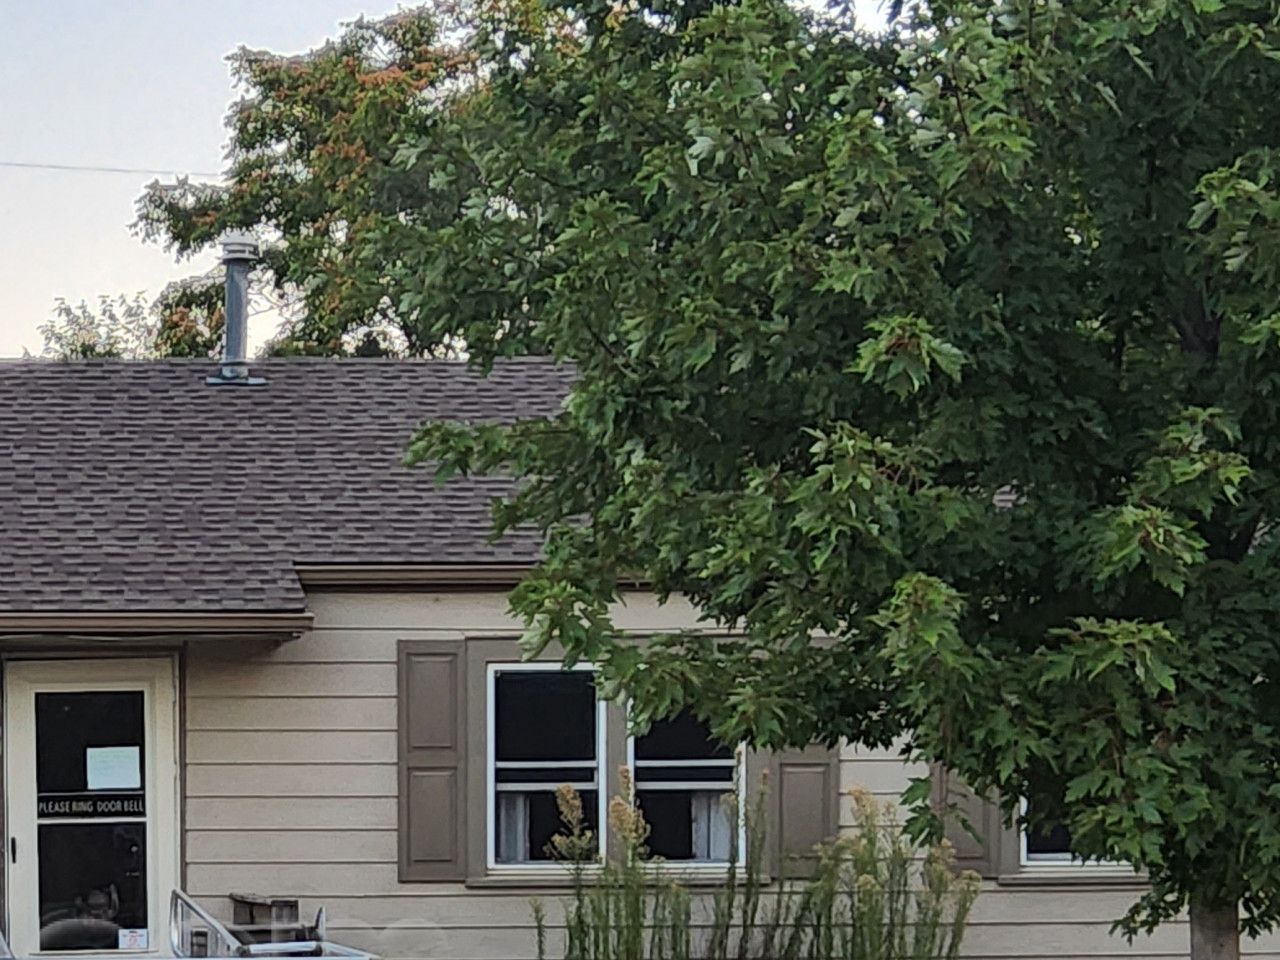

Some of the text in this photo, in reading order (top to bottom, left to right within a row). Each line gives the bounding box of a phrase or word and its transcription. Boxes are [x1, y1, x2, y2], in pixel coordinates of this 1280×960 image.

[38, 801, 70, 813] PLEASE
[97, 800, 122, 812] DOOR
[124, 798, 144, 812] BELL
